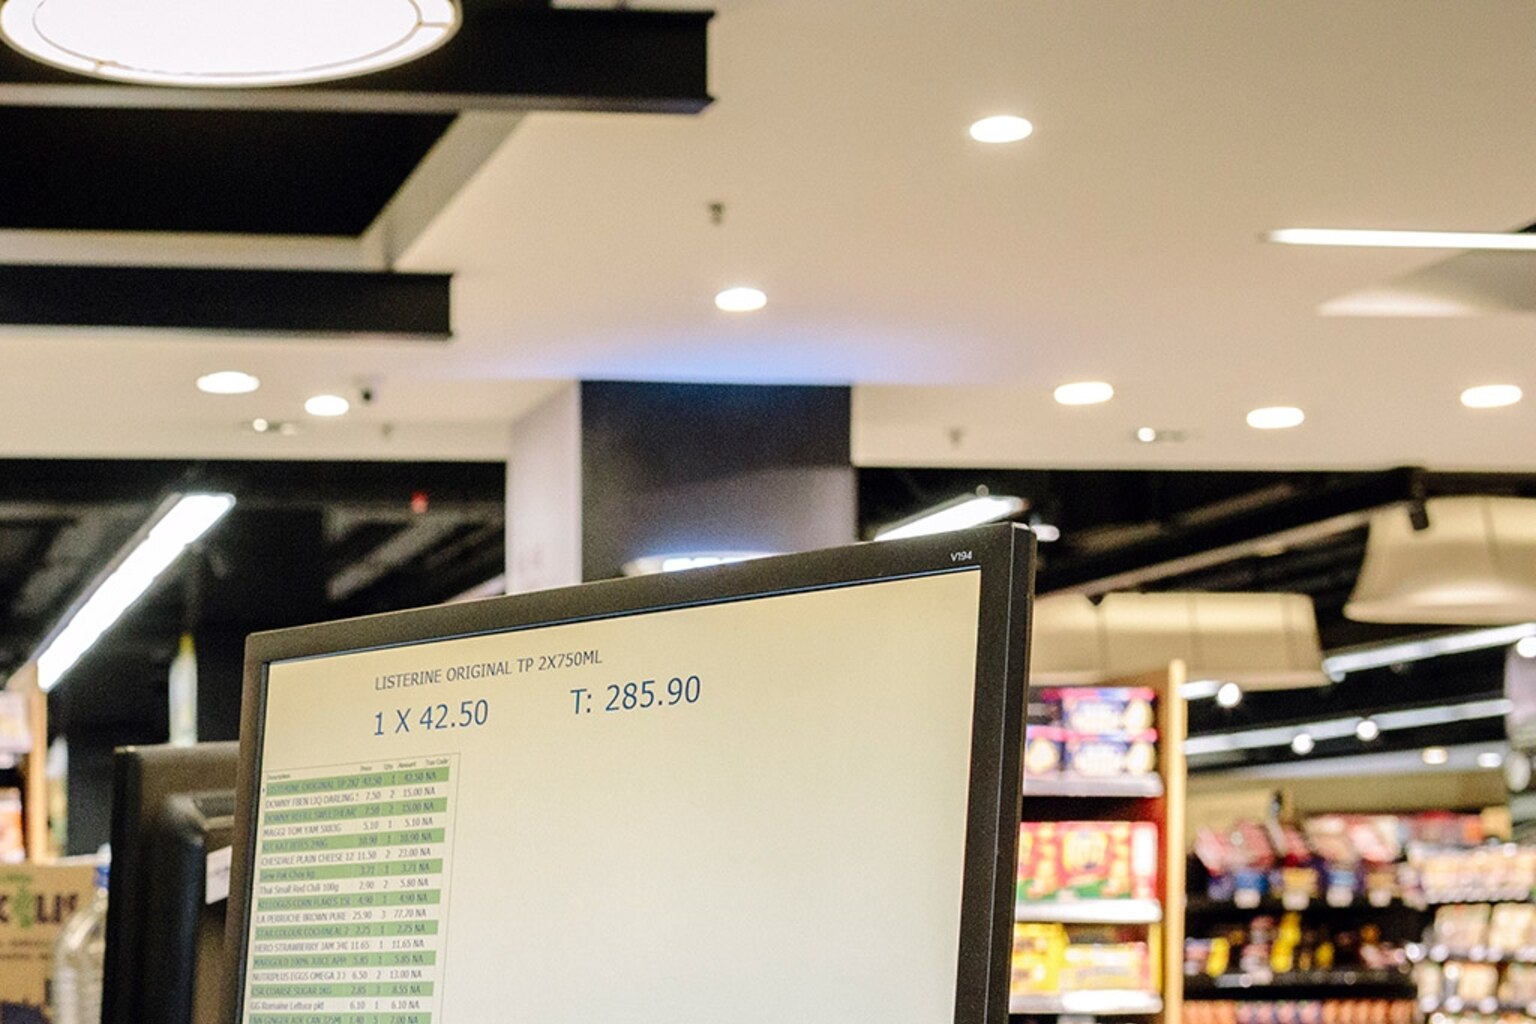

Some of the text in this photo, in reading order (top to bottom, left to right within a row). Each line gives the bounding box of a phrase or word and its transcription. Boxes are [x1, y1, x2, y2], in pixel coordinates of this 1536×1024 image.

[951, 551, 973, 562] V194
[375, 650, 602, 691] LISTERINE ORIGINAL TP 2X750ML
[570, 674, 701, 715] T: 285.90
[374, 699, 489, 736] 1 X 42.50
[423, 786, 435, 795] NA
[421, 816, 433, 825] NA
[419, 846, 431, 855] NA
[417, 877, 428, 886] NA
[415, 907, 426, 916] NA
[412, 938, 424, 947] NA
[410, 968, 422, 977] NA
[408, 999, 420, 1008] NA
